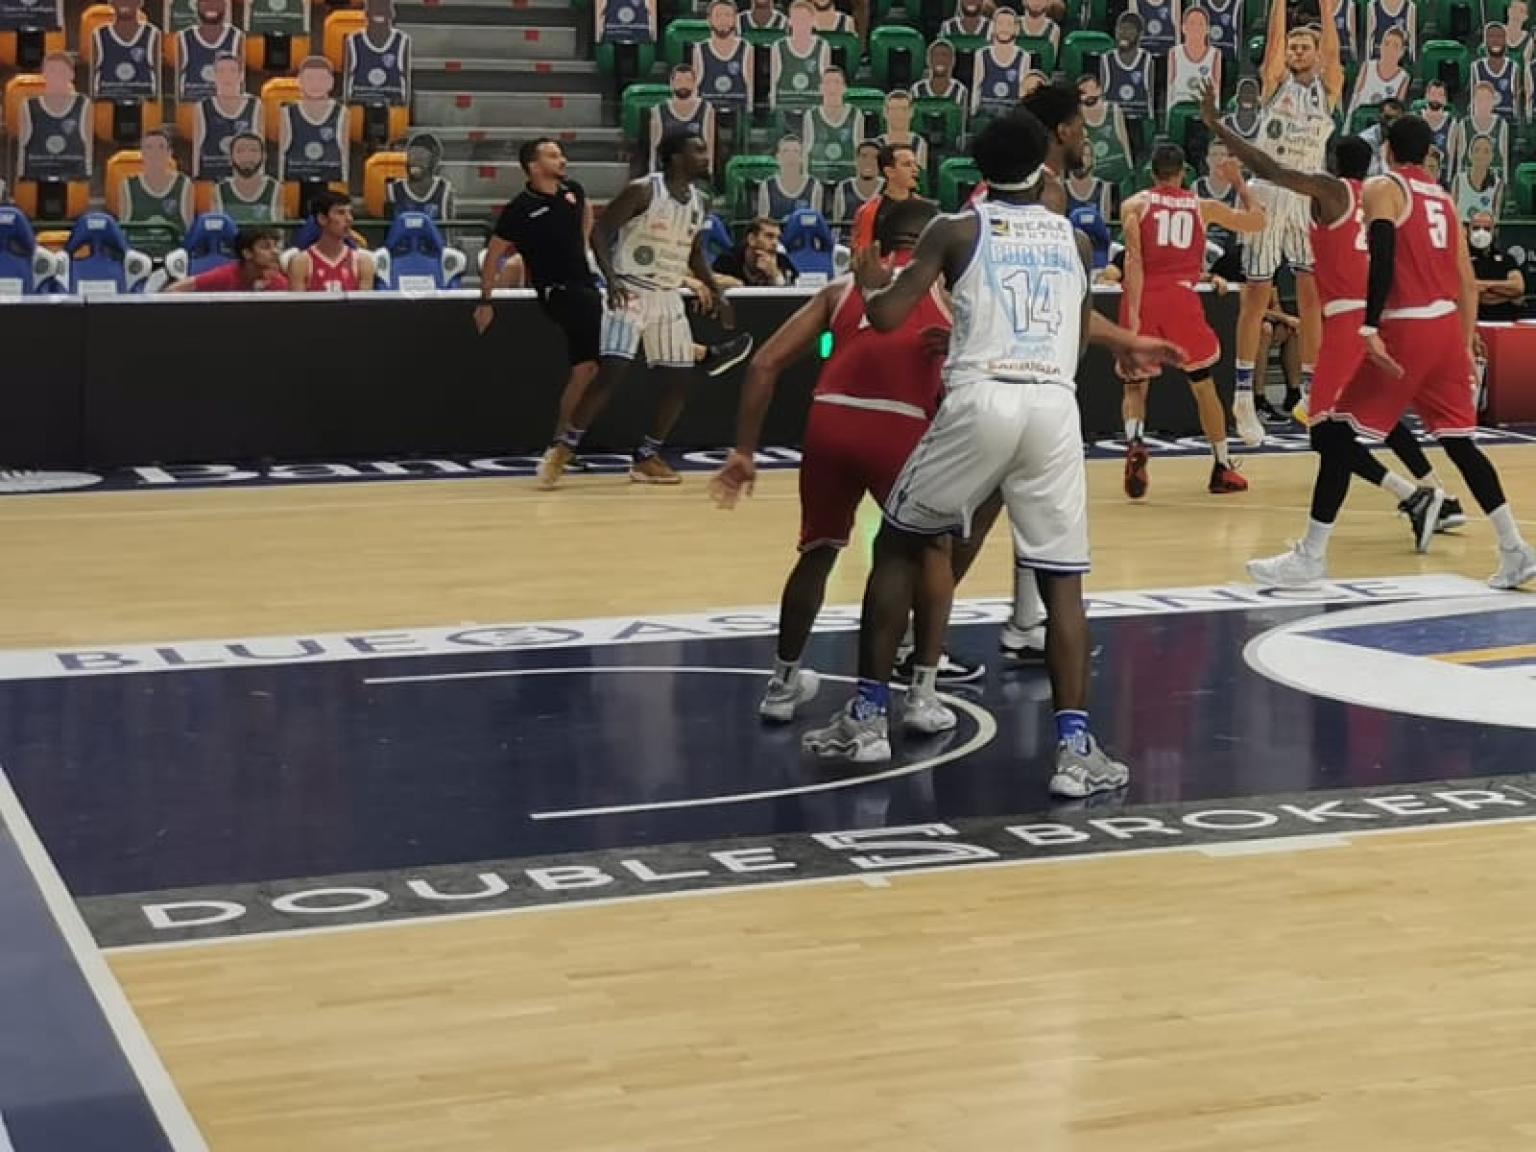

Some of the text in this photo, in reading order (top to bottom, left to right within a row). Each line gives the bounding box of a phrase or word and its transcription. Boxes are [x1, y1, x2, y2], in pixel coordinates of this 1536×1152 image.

[1153, 209, 1195, 249] 10
[1424, 199, 1448, 249] 5
[1001, 268, 1063, 336] 14
[55, 632, 429, 672] BLUE
[140, 846, 798, 931] DOUBLE
[1004, 789, 1526, 848] BROKER
